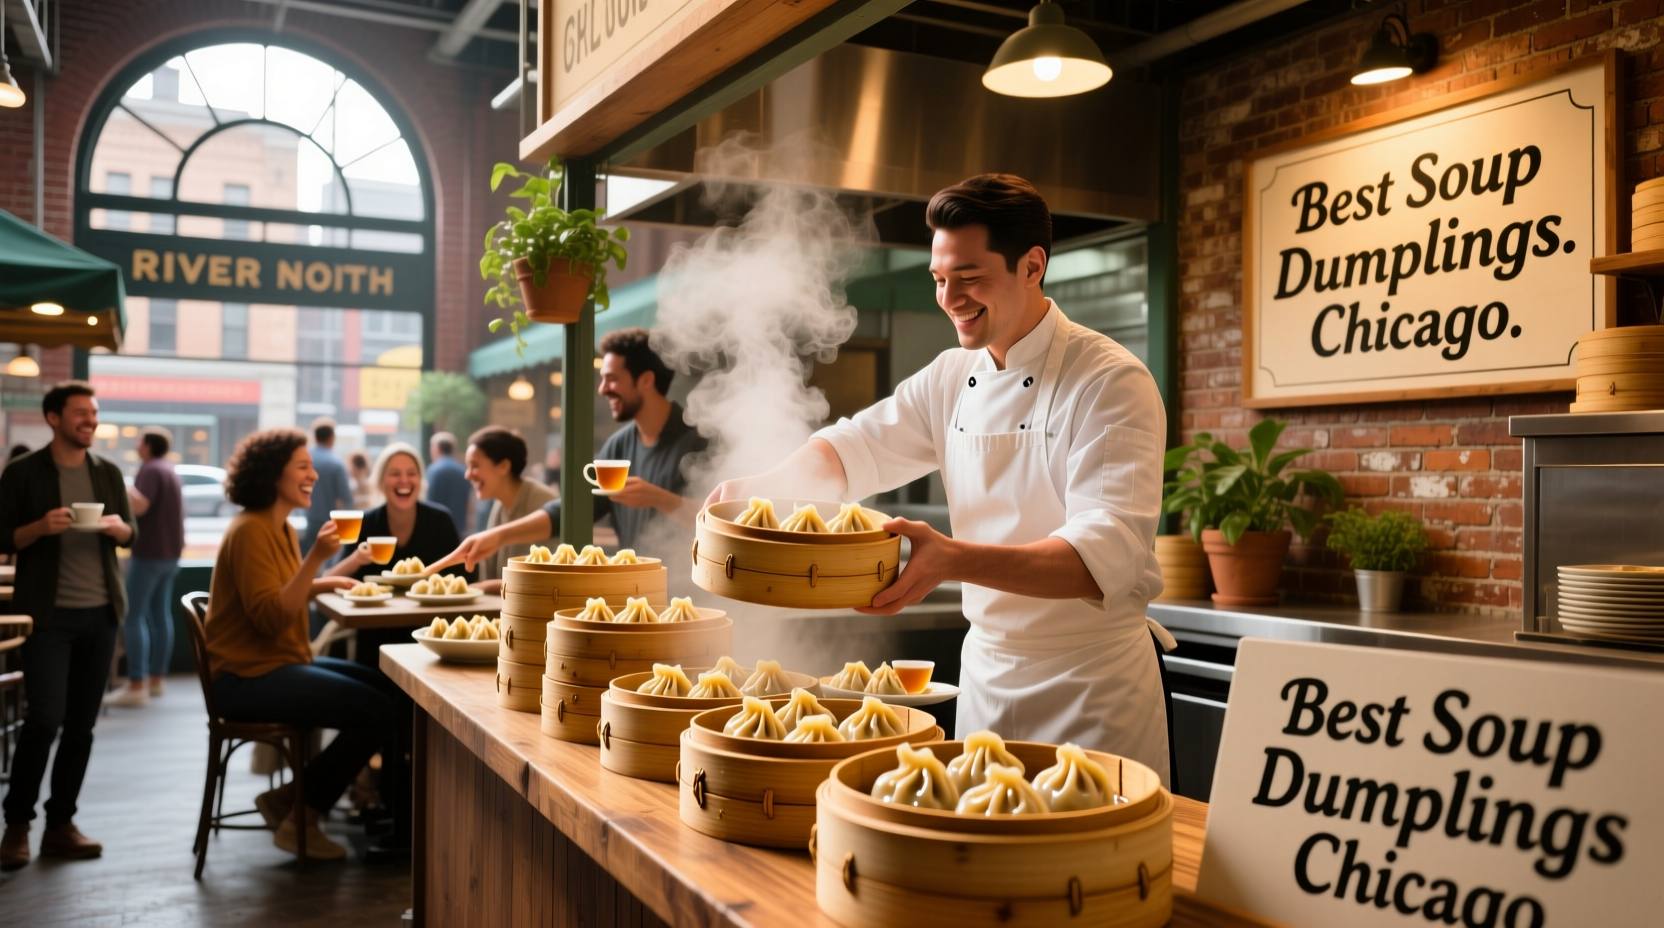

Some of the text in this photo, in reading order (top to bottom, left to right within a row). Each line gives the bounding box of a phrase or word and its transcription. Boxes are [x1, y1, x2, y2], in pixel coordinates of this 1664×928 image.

[1290, 144, 1542, 235] Best Soup
[132, 249, 262, 289] RIVER
[1273, 214, 1577, 301] Dumplings.
[1310, 300, 1523, 361] Chicago.
[1280, 677, 1604, 790] Best Soup
[1251, 746, 1630, 882] Dumplings
[1293, 832, 1547, 928] Chicago
